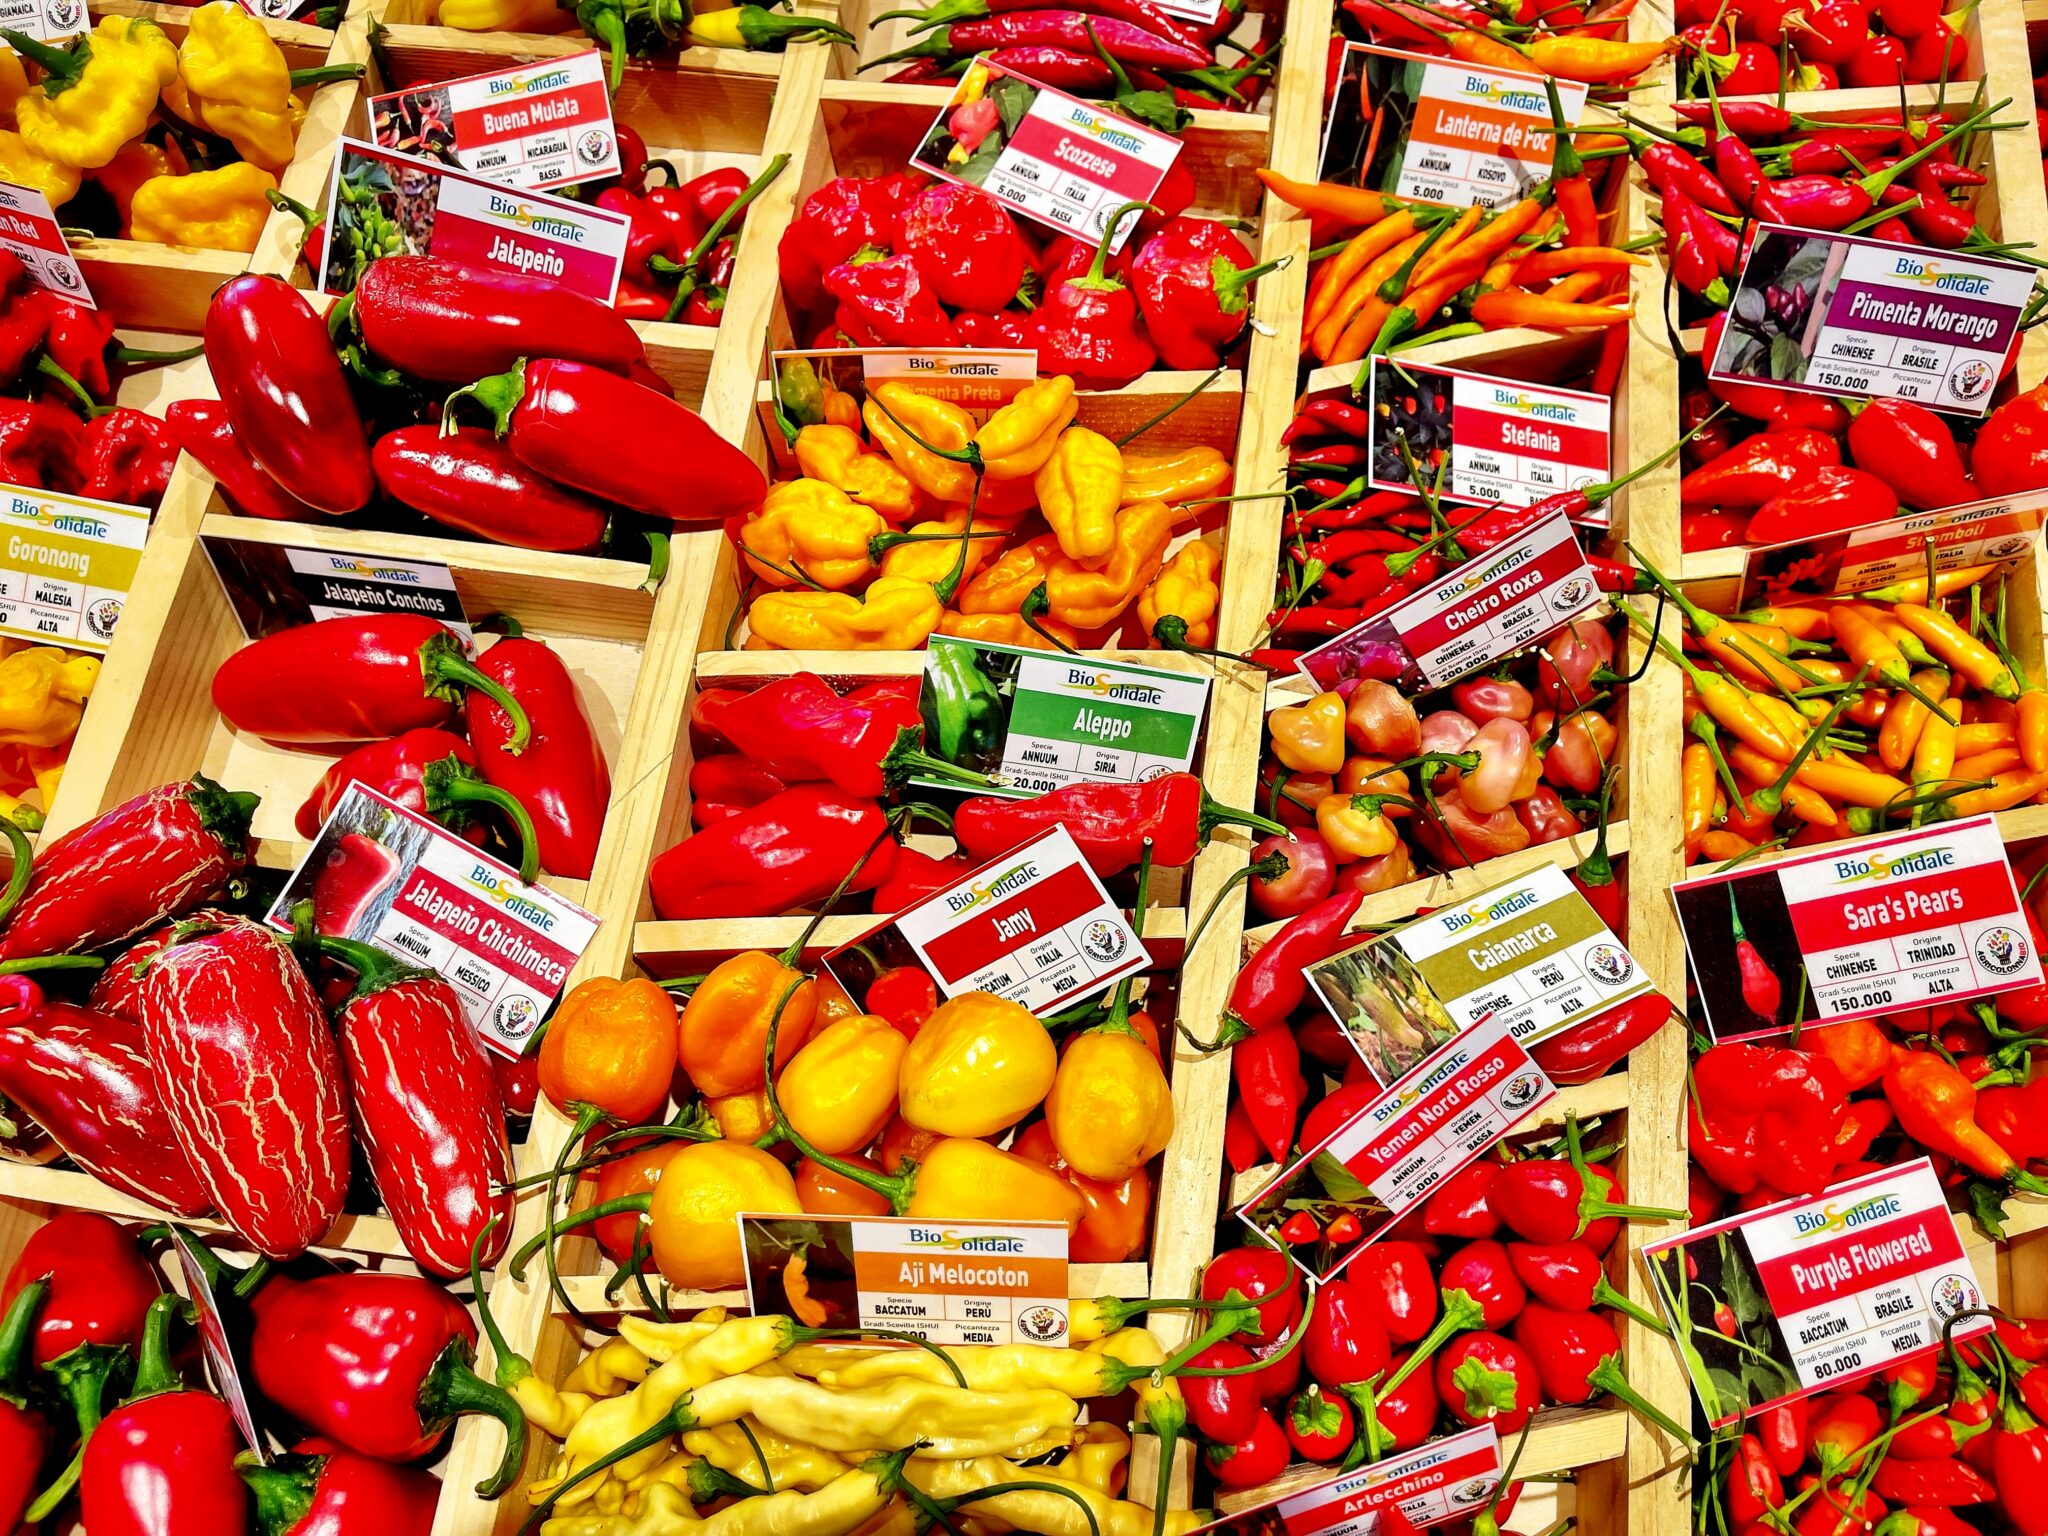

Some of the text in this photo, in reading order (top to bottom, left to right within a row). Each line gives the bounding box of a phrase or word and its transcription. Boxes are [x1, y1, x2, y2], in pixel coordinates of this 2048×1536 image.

[489, 72, 570, 94] BioSolidale
[1466, 76, 1546, 112] BioSolidale
[483, 97, 579, 135] Buena Mulata
[1071, 107, 1142, 155] BioSolidale
[1435, 109, 1500, 143] Lanterna
[1502, 122, 1521, 146] de
[527, 142, 568, 158] NICARAGUA
[1054, 138, 1116, 179] Scozzese
[476, 155, 507, 169] ANNUUM
[1418, 157, 1451, 172] ANNUUM
[539, 168, 562, 181] BASSA
[1010, 164, 1040, 182] ANNUUM
[1477, 167, 1507, 182] KOSOVO
[997, 184, 1026, 203] 5.000
[1063, 186, 1087, 202] ITALIA
[1413, 186, 1443, 200] 5.000
[490, 195, 584, 243] BioSolidale
[1050, 207, 1072, 224] BASSA
[10, 214, 40, 240] Red
[486, 236, 564, 277] Jalapeño
[1895, 257, 1989, 296] BioSolidale
[1848, 291, 1999, 342] Pimenta Morango
[1846, 334, 1867, 344] Specie
[1831, 343, 1875, 360] CHINENSE
[1912, 345, 1936, 356] Origine
[909, 358, 999, 376] BioSolidale
[1902, 354, 1939, 370] BRASILE
[1817, 372, 1869, 390] 150.000
[1893, 372, 1931, 386] Piccantezza
[908, 384, 1001, 401] imenta Preta
[1896, 384, 1919, 398] ALTA
[1495, 389, 1576, 422] BioSolidale
[1502, 422, 1560, 452] Stefania
[1469, 460, 1500, 475] ANNUUM
[1531, 471, 1553, 485] ITALIA
[1469, 485, 1500, 499] 5.000
[12, 498, 107, 538] BioSolidale
[8, 535, 90, 577] Goronong
[329, 557, 420, 584] BioSolidale
[1437, 547, 1534, 602] BioSolidale
[43, 582, 67, 592] Origine
[323, 581, 445, 612] Jalapeño Conchos
[35, 590, 72, 607] MALESIA
[1444, 595, 1499, 631] Cheiro
[1500, 569, 1544, 602] Roxa
[37, 620, 58, 633] ALTA
[1502, 607, 1535, 631] BRASILE
[1515, 628, 1536, 644] ALTA
[1435, 639, 1476, 665] CHINENSE
[1440, 653, 1489, 682] 200.000
[1068, 669, 1161, 705] BioSolidale
[1072, 707, 1132, 741] Aleppo
[1031, 742, 1053, 750] Specie
[1096, 751, 1120, 760] Origine
[1021, 750, 1058, 765] ANNUUM
[1094, 761, 1116, 774] SIRIA
[1004, 766, 1021, 774] Gradi
[1024, 769, 1048, 778] Scoville
[1013, 777, 1056, 792] 20.000
[1835, 849, 1955, 881] BioSolidale
[470, 863, 554, 932] BioSolidale
[946, 863, 1040, 913] BioSolidale
[1441, 889, 1539, 932] BioSolidale
[1844, 887, 1963, 931] Sara's Pears
[405, 879, 480, 936] Jalapeño
[478, 918, 566, 986] Chichimeca
[409, 925, 430, 941] Specie
[991, 907, 1037, 942] Jamy
[393, 932, 431, 959] ANNUUM
[1030, 939, 1053, 955] Origine
[1913, 933, 1942, 947] Origine
[1035, 948, 1063, 968] ITALIA
[1834, 950, 1860, 962] Specie
[1907, 943, 1956, 964] TRINIDAD
[468, 959, 490, 976] Origine
[974, 969, 994, 984] Specie
[1040, 963, 1076, 984] Piccantezza
[1532, 962, 1556, 976] Origine
[1826, 959, 1878, 980] CHINENSE
[1912, 965, 1960, 980] Piccantezza
[455, 966, 490, 992] MESSICO
[1052, 976, 1079, 994] MEDA
[1540, 968, 1564, 988] PERÙ
[1928, 979, 1954, 995] ALTA
[1471, 991, 1493, 1004] Specie
[1544, 985, 1581, 1005] Piccantezza
[1818, 988, 1840, 999] Gradi
[1841, 981, 1870, 994] Scoville
[1561, 998, 1584, 1015] ALTA
[1830, 990, 1893, 1013] 150.000
[1371, 1052, 1471, 1124] BioSolidale
[1367, 1118, 1423, 1166] Yemen
[1419, 1088, 1461, 1127] Nord
[1456, 1057, 1505, 1097] Rosso
[1453, 1112, 1483, 1137] YEMEN
[1466, 1129, 1494, 1153] BASSA
[1391, 1156, 1427, 1187] ANNUUM
[1405, 1171, 1440, 1200] 5.000
[1794, 1197, 1903, 1234] BioSolidale
[909, 1228, 1024, 1253] BioSolidale
[1791, 1224, 1933, 1295] Purple Flowered
[899, 1261, 1029, 1288] Aji Melocoton
[887, 1296, 912, 1305] Specie
[964, 1300, 992, 1308] Origine
[1875, 1287, 1901, 1302] Origine
[875, 1304, 926, 1316] BACCATUM
[965, 1305, 992, 1318] PERÙ
[1806, 1310, 1831, 1325] Specie
[1874, 1296, 1914, 1320] BRASILE
[864, 1321, 915, 1330] Gradi Scoville
[955, 1323, 1000, 1332] Piccantezza
[1800, 1317, 1849, 1345] BACCATUM
[1880, 1319, 1922, 1339] Piccantezza
[963, 1331, 994, 1343] MEDIA
[1891, 1332, 1922, 1353] MEDIA
[1798, 1353, 1819, 1367] Gradi
[1819, 1344, 1845, 1360] Scoville
[1814, 1352, 1862, 1380] 80.000
[1335, 1451, 1448, 1495] BioSolidale
[1343, 1470, 1445, 1516] Arlecchino
